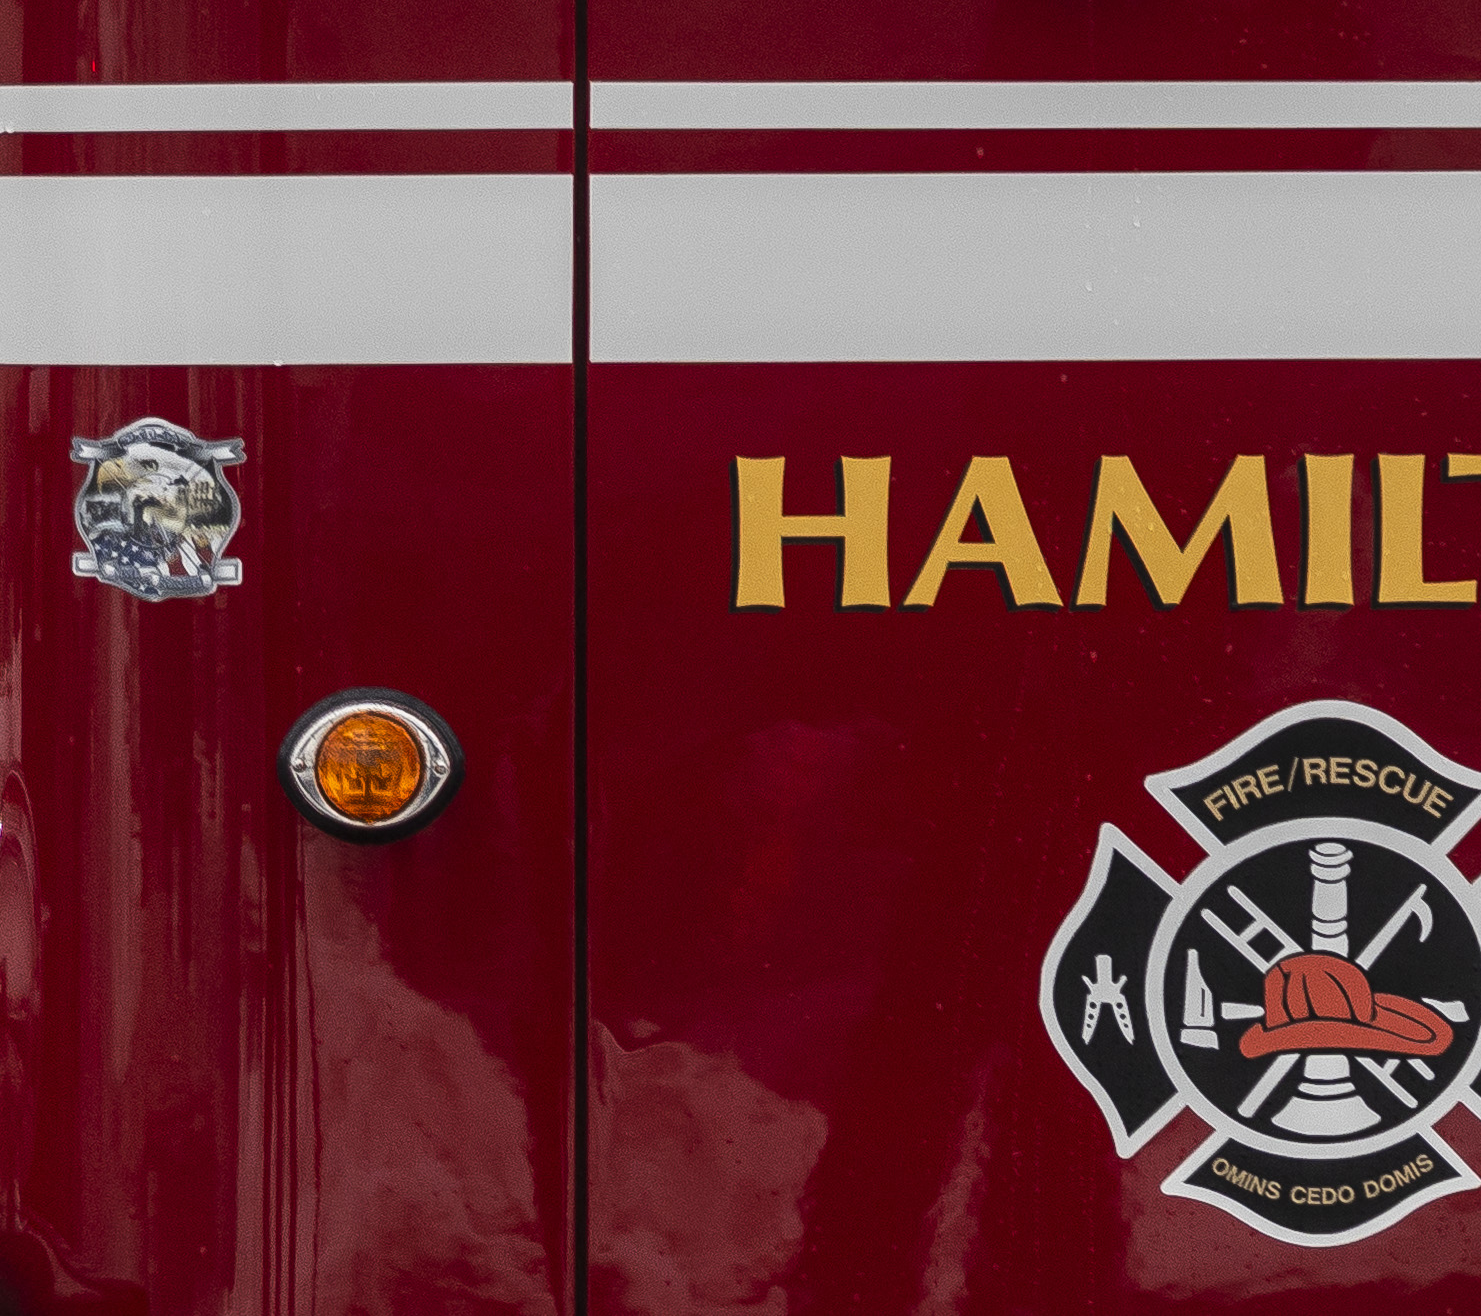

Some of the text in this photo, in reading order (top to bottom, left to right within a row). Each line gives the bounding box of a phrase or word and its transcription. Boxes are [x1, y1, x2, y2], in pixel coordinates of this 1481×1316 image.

[1203, 756, 1454, 822] FIRE/RESCUE
[1212, 1154, 1434, 1205] OMINS CEDO DOMIS
